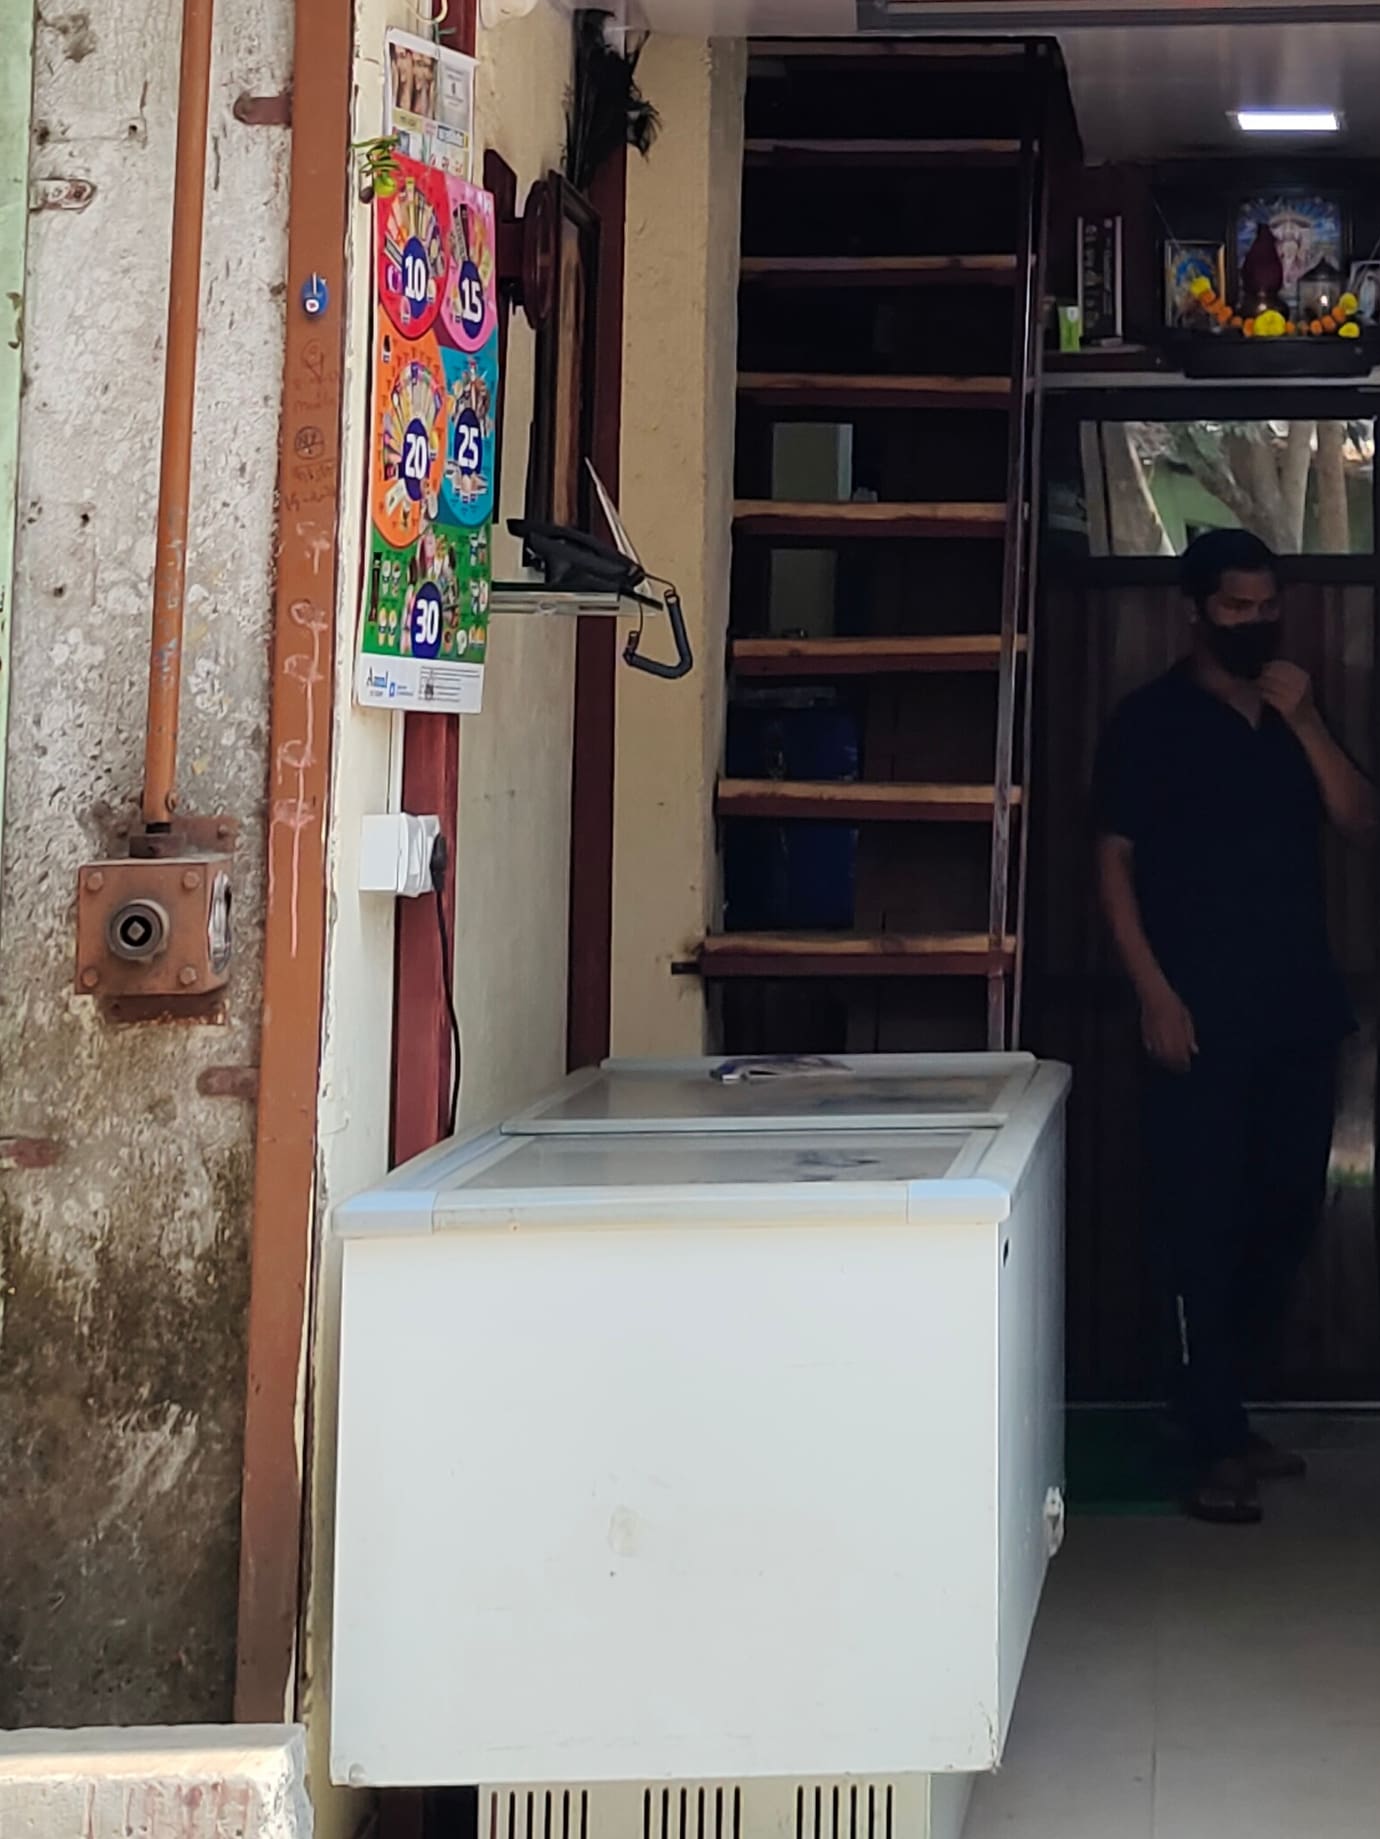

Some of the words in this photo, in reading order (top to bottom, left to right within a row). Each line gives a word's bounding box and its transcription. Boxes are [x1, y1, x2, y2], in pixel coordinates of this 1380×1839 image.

[404, 255, 426, 302] 10
[460, 278, 483, 321] 15
[405, 432, 427, 480] 20
[458, 424, 479, 470] 25
[415, 598, 439, 646] 30
